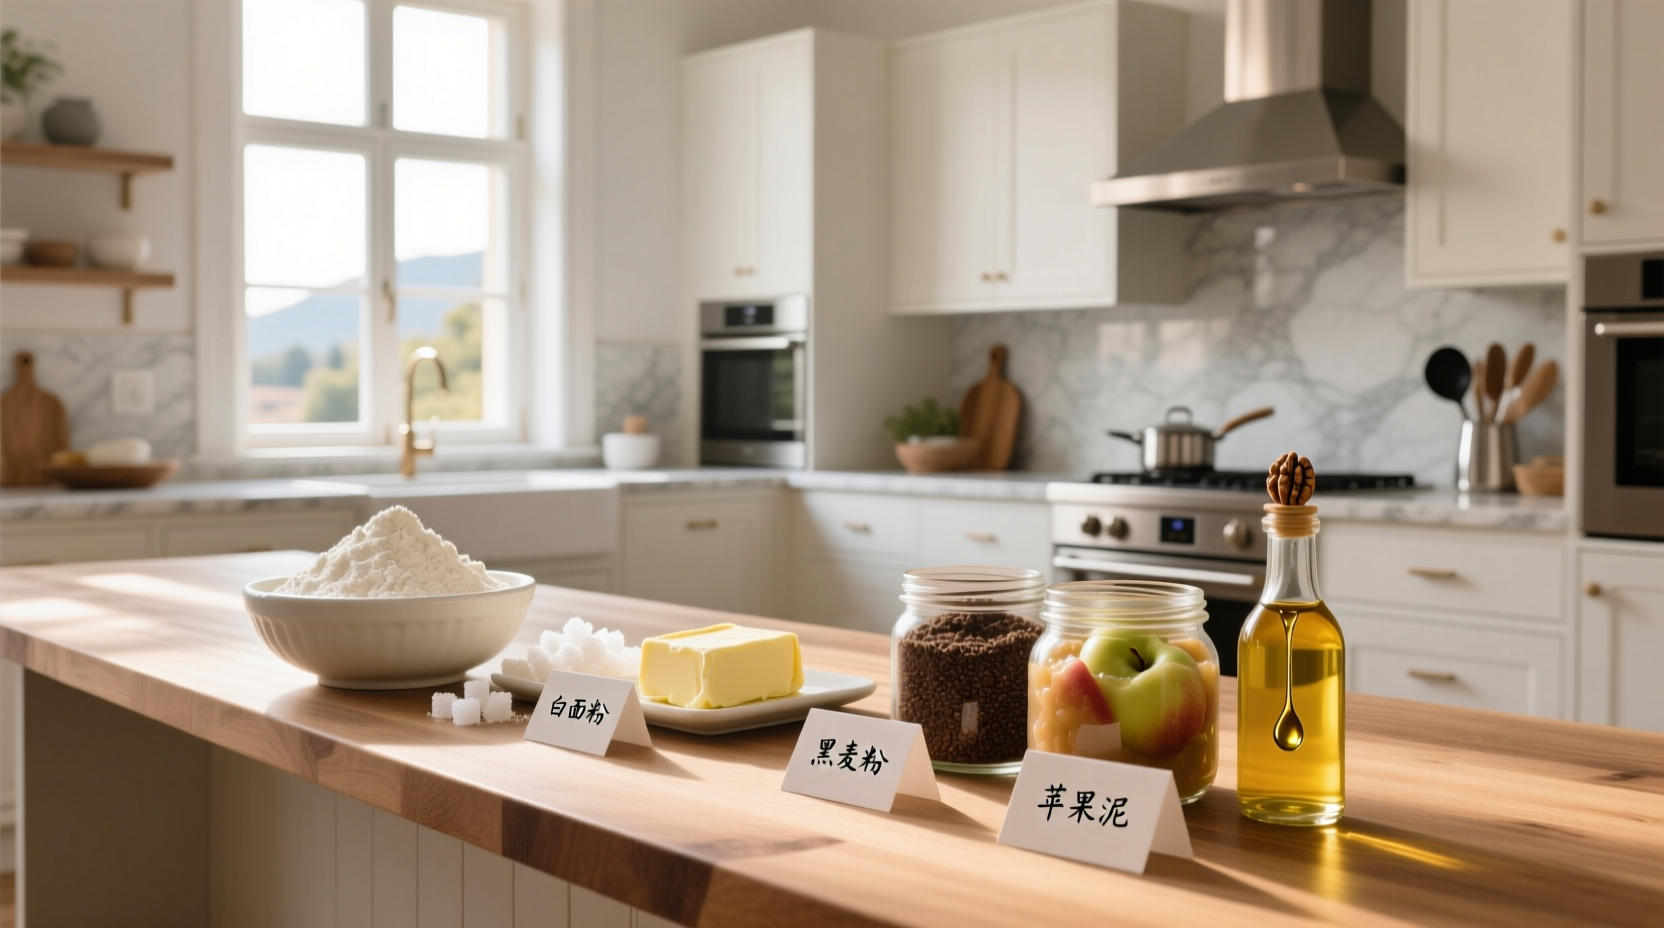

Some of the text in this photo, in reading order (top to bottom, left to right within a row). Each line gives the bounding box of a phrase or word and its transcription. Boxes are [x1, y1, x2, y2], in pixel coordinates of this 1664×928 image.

[550, 695, 610, 726] 白面粉
[811, 739, 889, 776] 黑麦粉
[1037, 783, 1128, 828] 苹果泥
